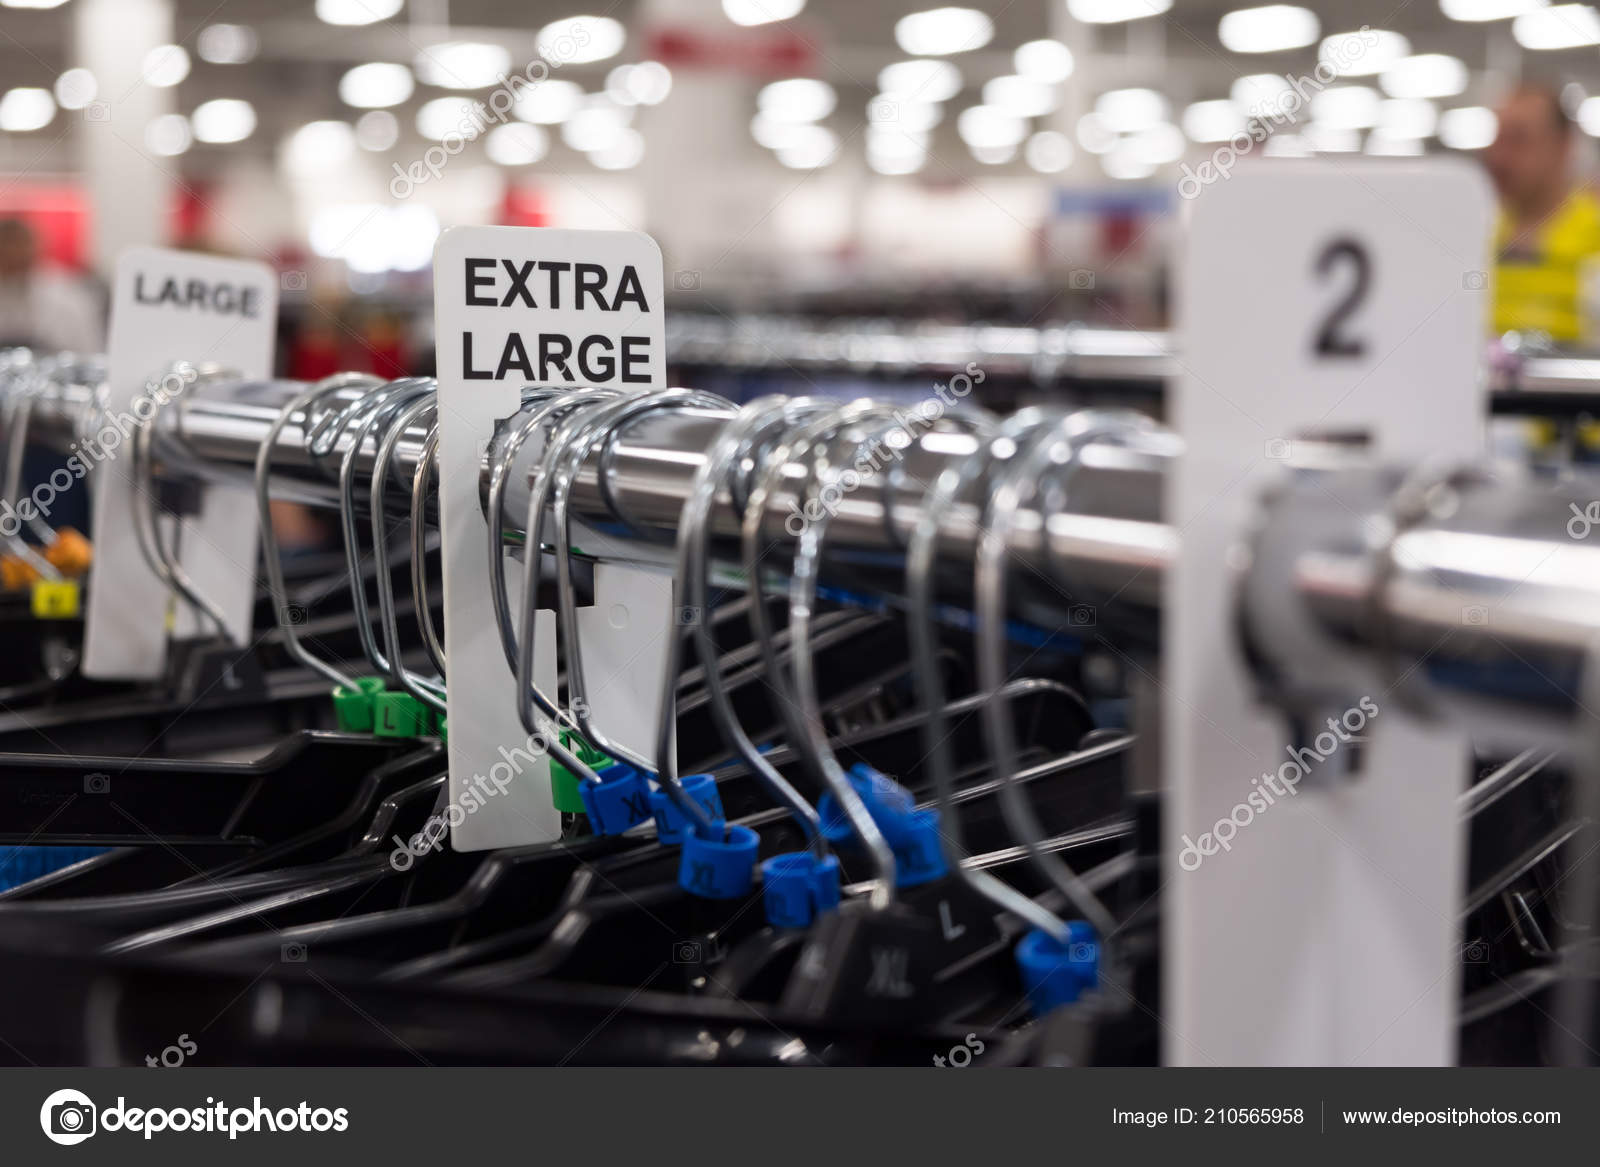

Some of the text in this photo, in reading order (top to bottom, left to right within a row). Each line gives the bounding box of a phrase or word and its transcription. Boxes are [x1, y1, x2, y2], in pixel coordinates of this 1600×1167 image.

[134, 271, 262, 319] LARGE
[464, 257, 651, 313] EXTRA
[1313, 236, 1373, 359] 2
[462, 331, 653, 384] LARGE
[382, 704, 396, 730] L
[939, 902, 966, 940] L
[864, 946, 915, 998] XL
